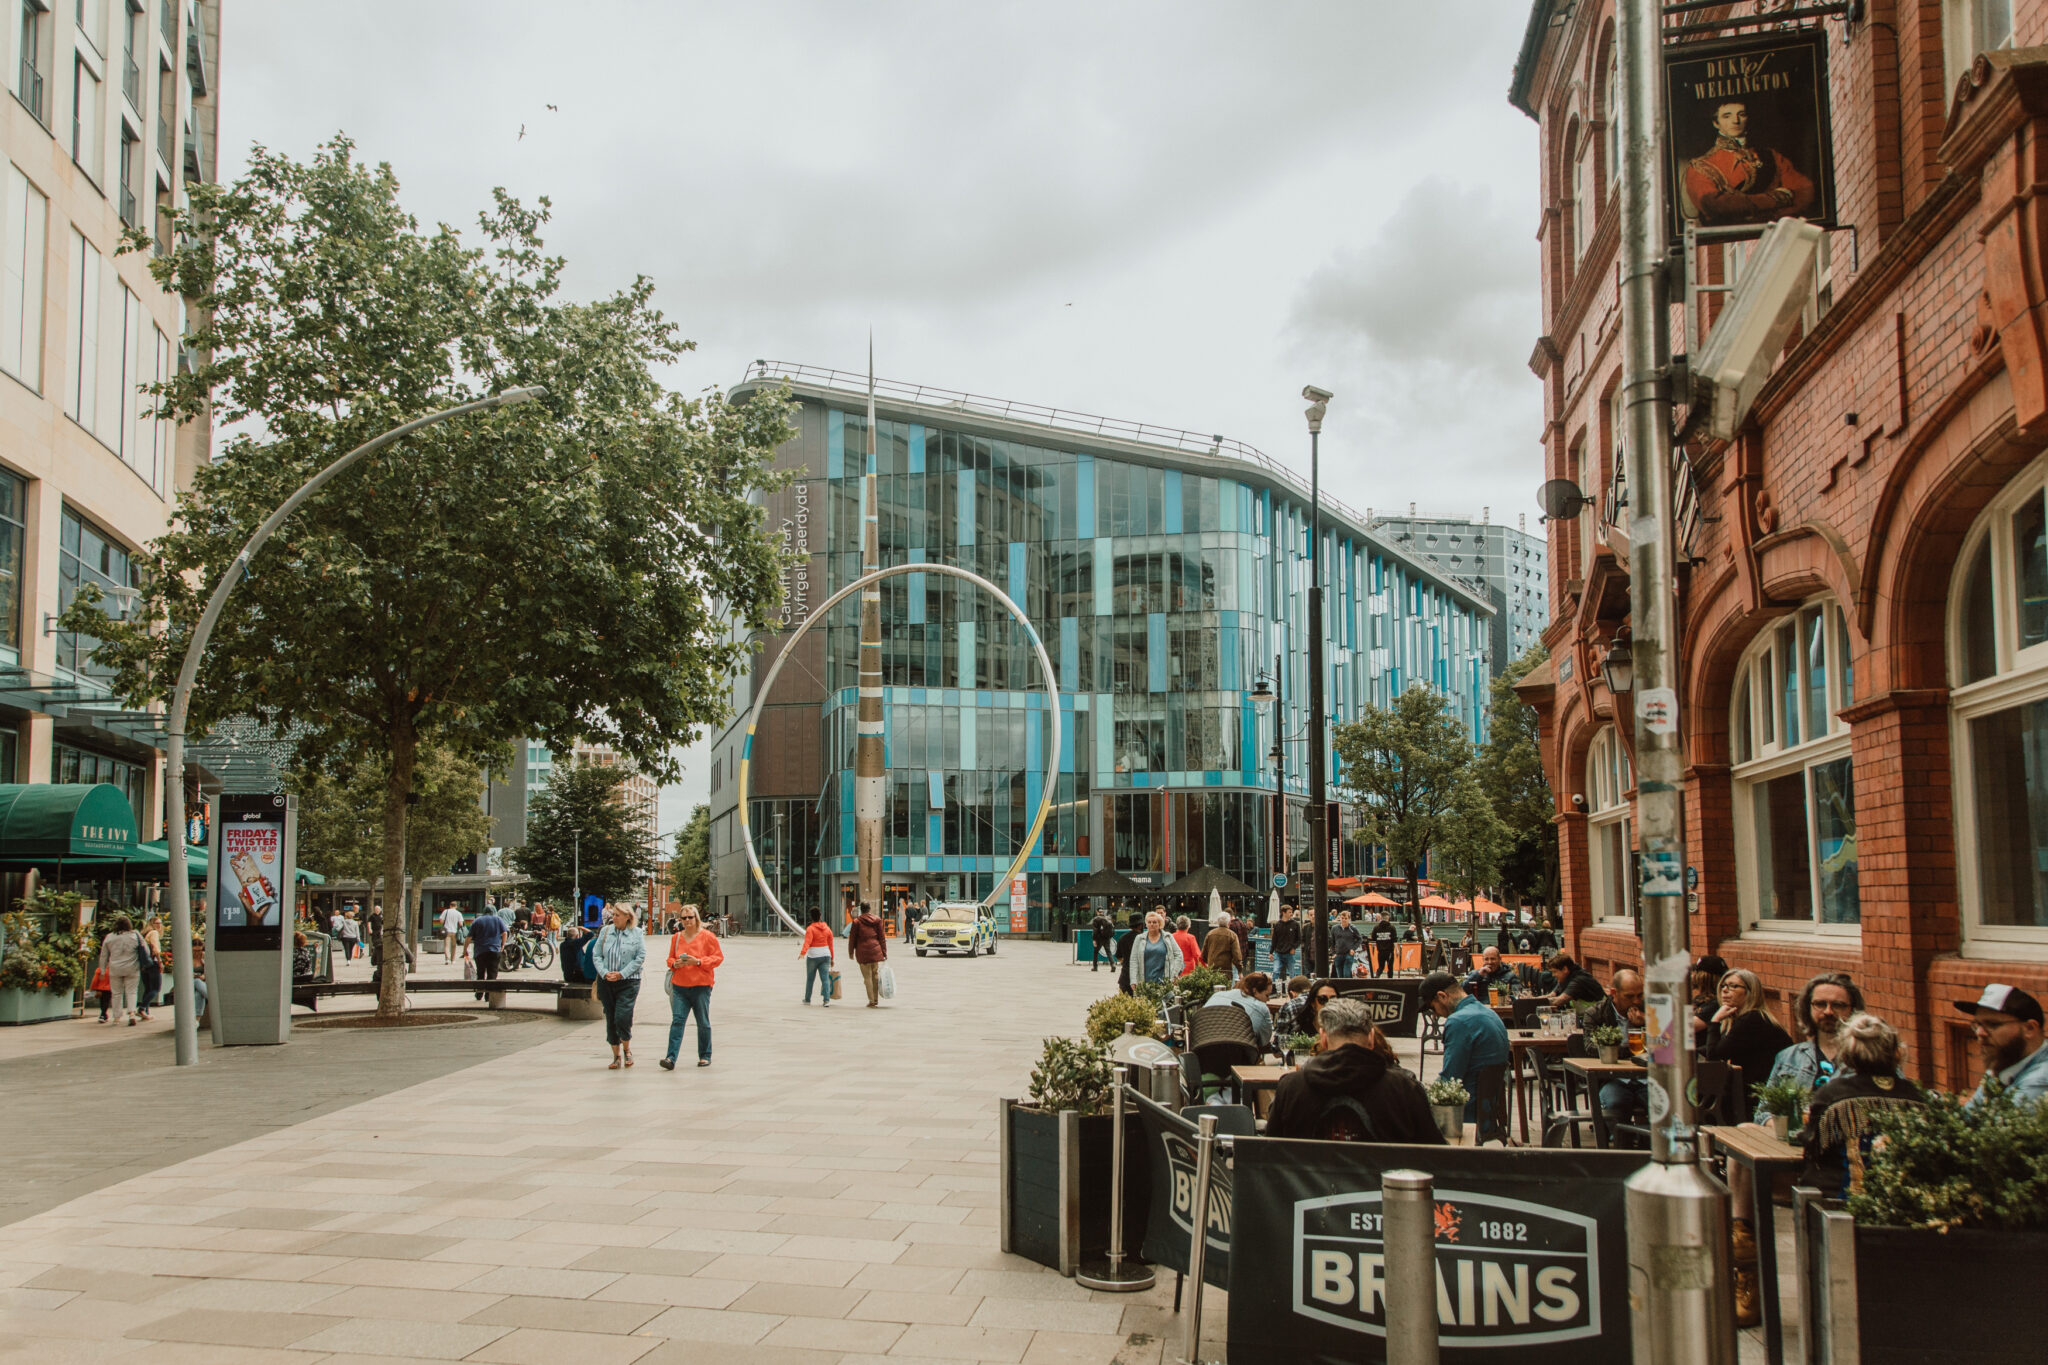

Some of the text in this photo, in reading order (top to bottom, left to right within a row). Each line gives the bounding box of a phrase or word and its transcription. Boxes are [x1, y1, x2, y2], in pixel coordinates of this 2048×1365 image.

[1707, 52, 1775, 78] DUKE of
[1695, 72, 1789, 99] WELLINGTON
[242, 813, 261, 821] global
[82, 825, 129, 841] THE IVY
[227, 829, 277, 837] FRIDAY'S
[226, 838, 277, 846] TWISTER
[1479, 1221, 1527, 1242] 1882
